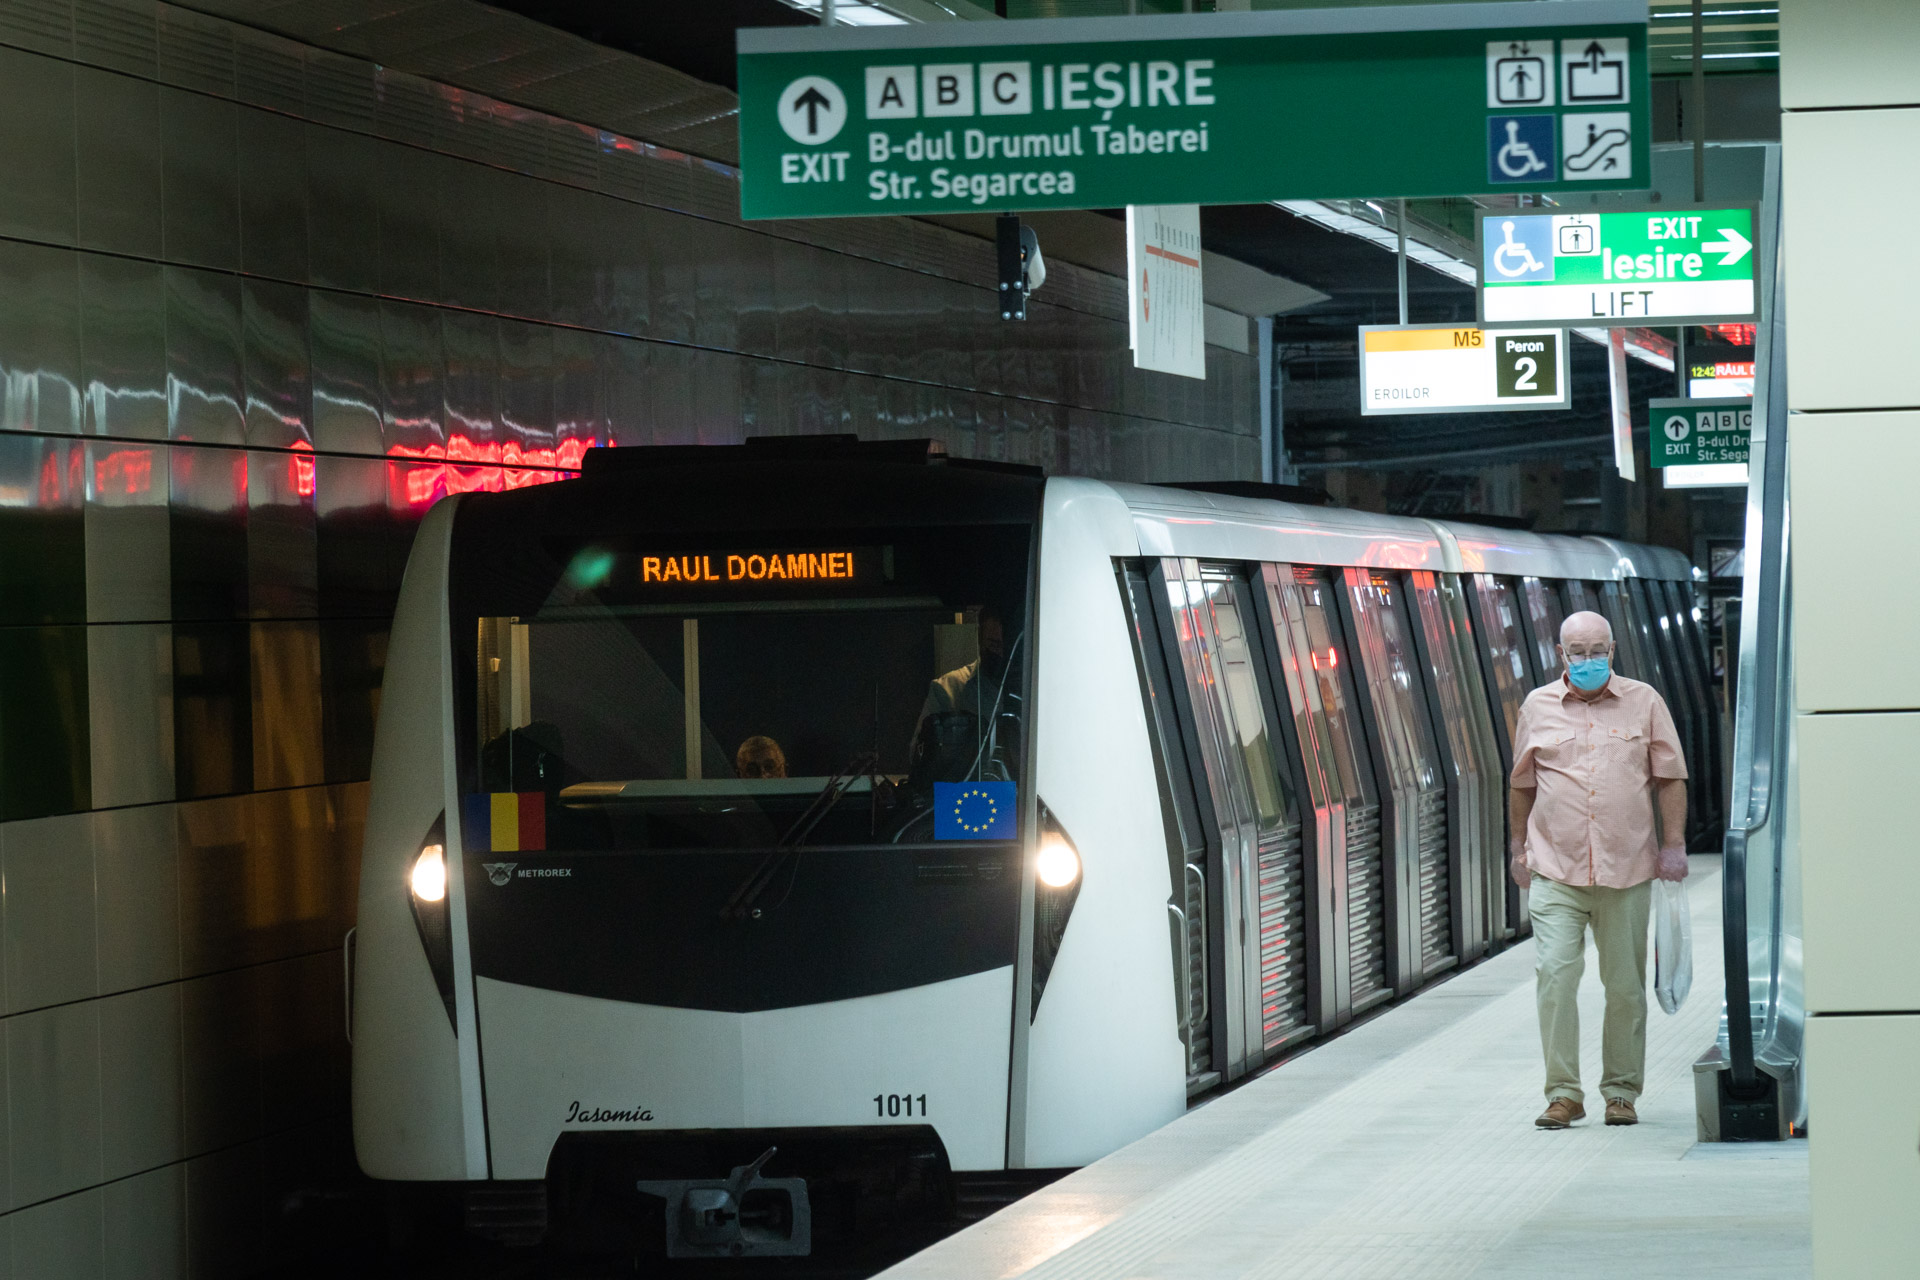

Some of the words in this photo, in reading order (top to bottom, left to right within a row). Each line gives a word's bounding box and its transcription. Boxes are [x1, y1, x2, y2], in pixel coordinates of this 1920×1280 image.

[879, 76, 904, 109] A
[936, 75, 959, 105] B
[992, 72, 1019, 105] C
[868, 129, 955, 163] B-dul
[964, 126, 1084, 160] Drumul
[1091, 122, 1210, 155] Taberei
[781, 152, 850, 184] EXIT
[868, 170, 923, 201] Str.
[930, 168, 1076, 204] Segarcea
[1648, 216, 1702, 240] EXIT
[1591, 290, 1655, 318] LIFT
[1453, 330, 1482, 348] M5
[1505, 340, 1545, 354] Peron
[1514, 356, 1538, 391] 2
[1374, 387, 1431, 401] EROILOR
[1701, 416, 1711, 428] A
[1722, 415, 1731, 427] B
[1743, 414, 1752, 426] C
[1665, 443, 1691, 455] EXIT
[1697, 435, 1729, 447] B-dul
[1697, 450, 1718, 461] Str.
[1720, 449, 1749, 462] Sega
[643, 556, 719, 582] RAUL
[727, 552, 854, 581] DOAMNEI
[518, 868, 572, 878] METROREX
[873, 1093, 928, 1118] 1011
